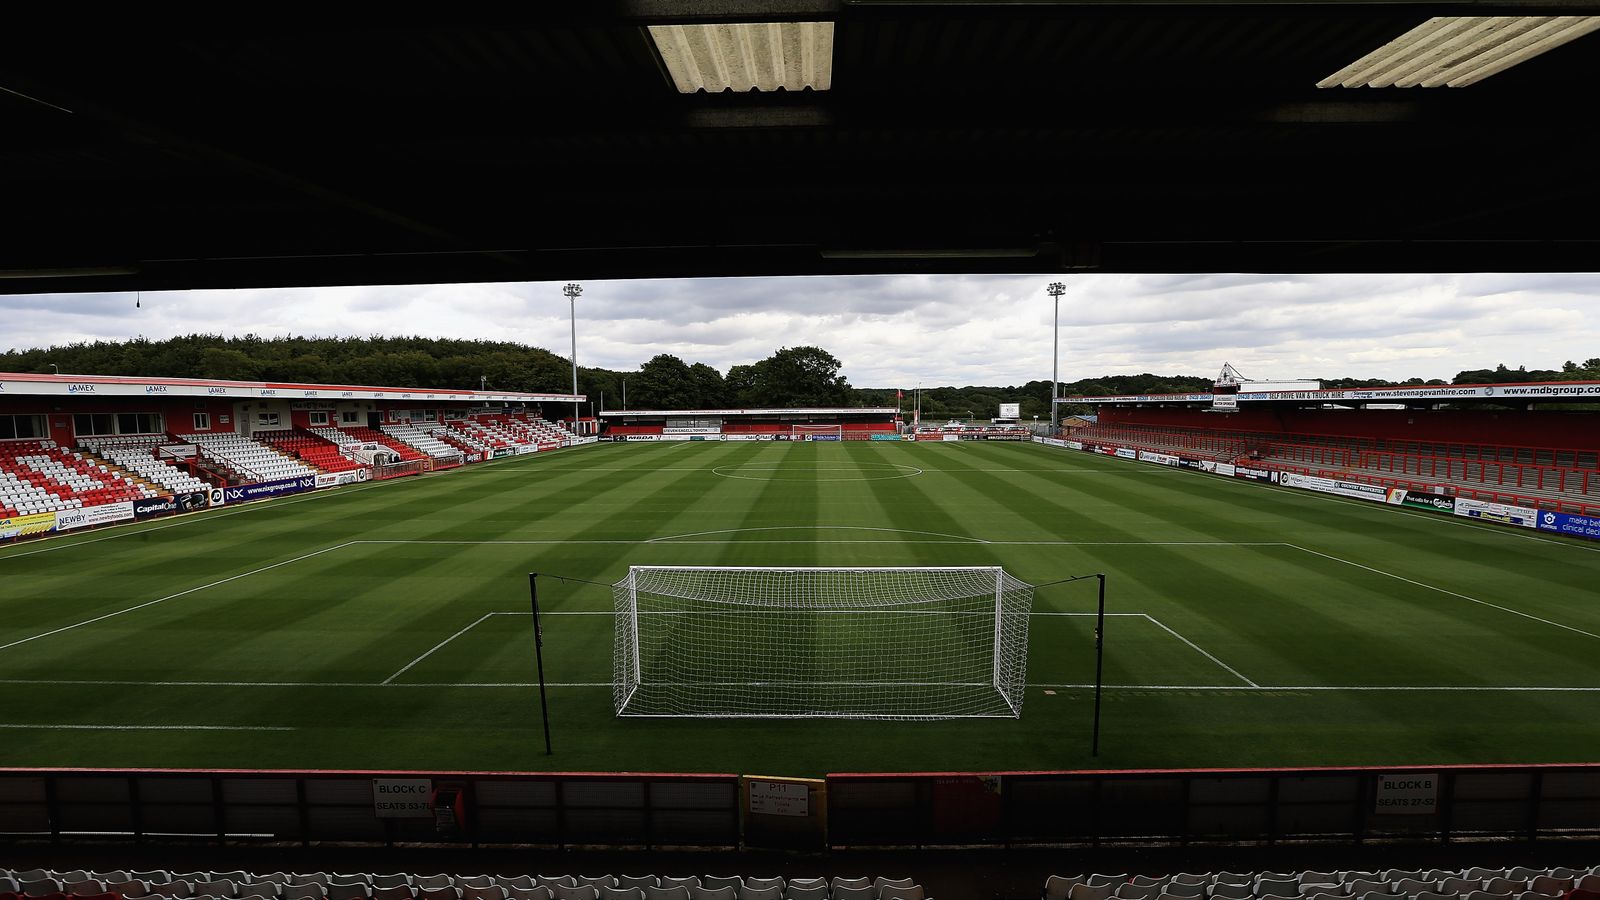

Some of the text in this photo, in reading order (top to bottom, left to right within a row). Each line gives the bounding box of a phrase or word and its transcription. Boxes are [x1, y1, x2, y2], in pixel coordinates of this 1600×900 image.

[68, 384, 95, 393] LAMEX
[145, 385, 168, 393] LAMEX
[1375, 388, 1476, 398] www.stevenagevanhire.com
[1504, 386, 1600, 396] www.mdbgroup.co
[1269, 392, 1279, 400] SELF
[1312, 391, 1330, 399] TRUCK
[1332, 390, 1345, 399] HIRE
[247, 480, 298, 495] www.nixgroup.co.uk
[59, 514, 86, 525] NEWBY
[1569, 516, 1587, 525] make
[1562, 523, 1584, 533] clinical
[379, 785, 426, 793] BLOCK C
[769, 783, 787, 792] P11
[1384, 781, 1432, 789] BLOCK B
[376, 802, 406, 810] SEATS
[1379, 798, 1409, 807] SEATS
